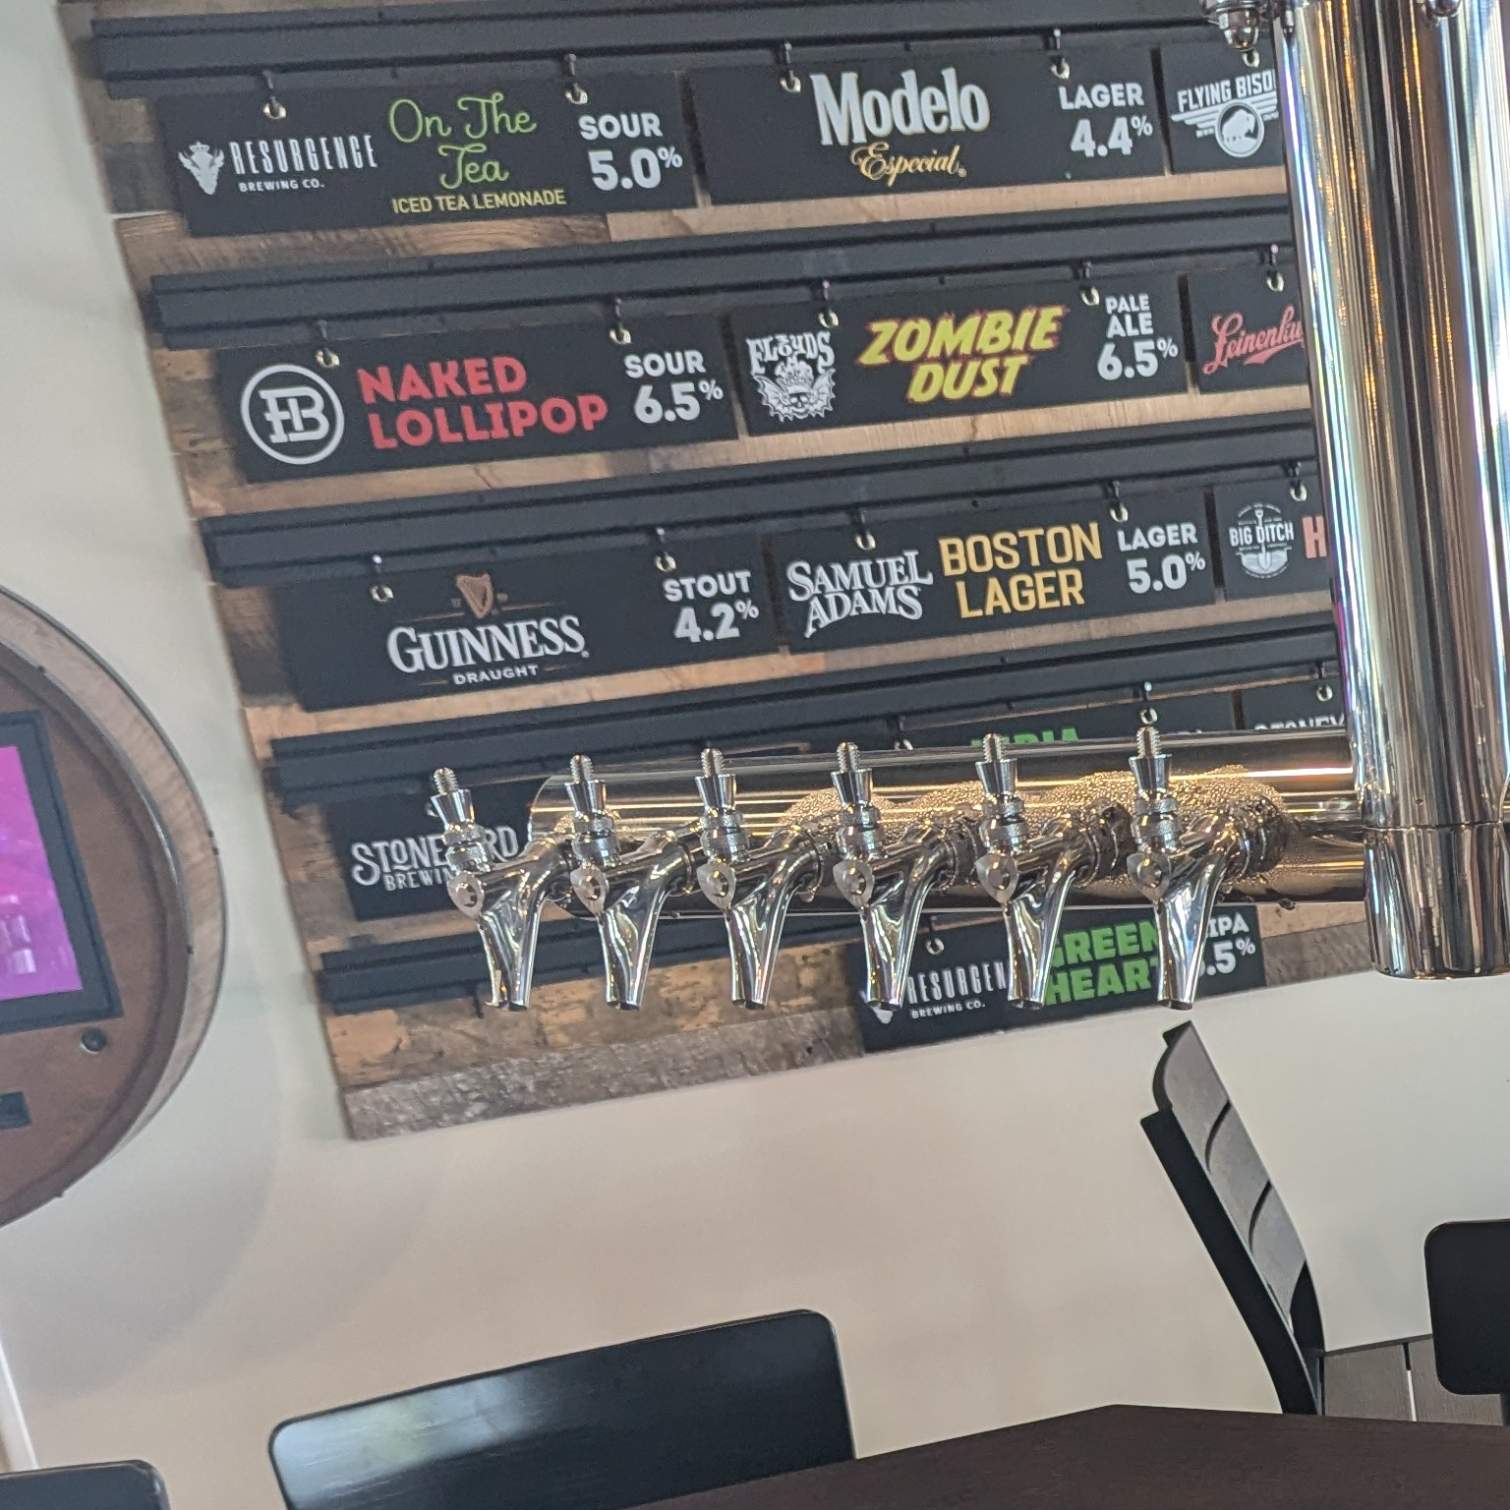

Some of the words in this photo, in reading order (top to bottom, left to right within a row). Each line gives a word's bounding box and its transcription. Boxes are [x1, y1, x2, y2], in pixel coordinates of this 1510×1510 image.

[388, 99, 451, 143] On
[457, 92, 537, 137] The
[810, 67, 991, 147] Modelo
[1058, 83, 1145, 110] LAGER
[1177, 80, 1232, 113] FLYING
[578, 112, 663, 140] SOUR
[1070, 115, 1153, 159] 4.4%
[229, 134, 378, 175] RESURGENCE
[438, 143, 510, 190] Tea
[590, 145, 684, 192] 5.0%
[851, 141, 966, 187] Especial
[238, 179, 297, 193] BREWING
[301, 177, 325, 190] CO.
[392, 196, 433, 214] ICED
[435, 194, 469, 211] TEA
[472, 188, 566, 210] LEMONADE
[1105, 293, 1150, 314] PALE
[1105, 312, 1153, 338] ALE
[859, 305, 1066, 366] ZOMBIE
[1202, 305, 1304, 375] Leinenku
[356, 356, 527, 404] NAKED
[624, 350, 706, 379] SOUR
[907, 355, 1029, 403] DUST
[1097, 338, 1179, 381] 6.5%
[367, 395, 609, 450] LOLLIPOP
[633, 378, 725, 425] 6.5%
[938, 521, 1103, 577] BOSTON
[1117, 522, 1199, 552] LAGER
[1229, 526, 1253, 547] BIG
[1255, 521, 1294, 544] DITCH
[663, 570, 752, 602] STOUT
[787, 550, 934, 603] SAMUEL
[1127, 552, 1206, 594] 5.0%
[804, 584, 923, 639] ADAMS
[955, 570, 1086, 620] LAGER
[674, 600, 759, 643] 4.2%
[387, 615, 586, 674] GUINNESS
[453, 664, 538, 686] DRAUGHT
[351, 825, 519, 886] STONERD
[1199, 937, 1256, 977] .5%
[907, 961, 1007, 1004] RESURGEN
[911, 1003, 963, 1019] BREWING
